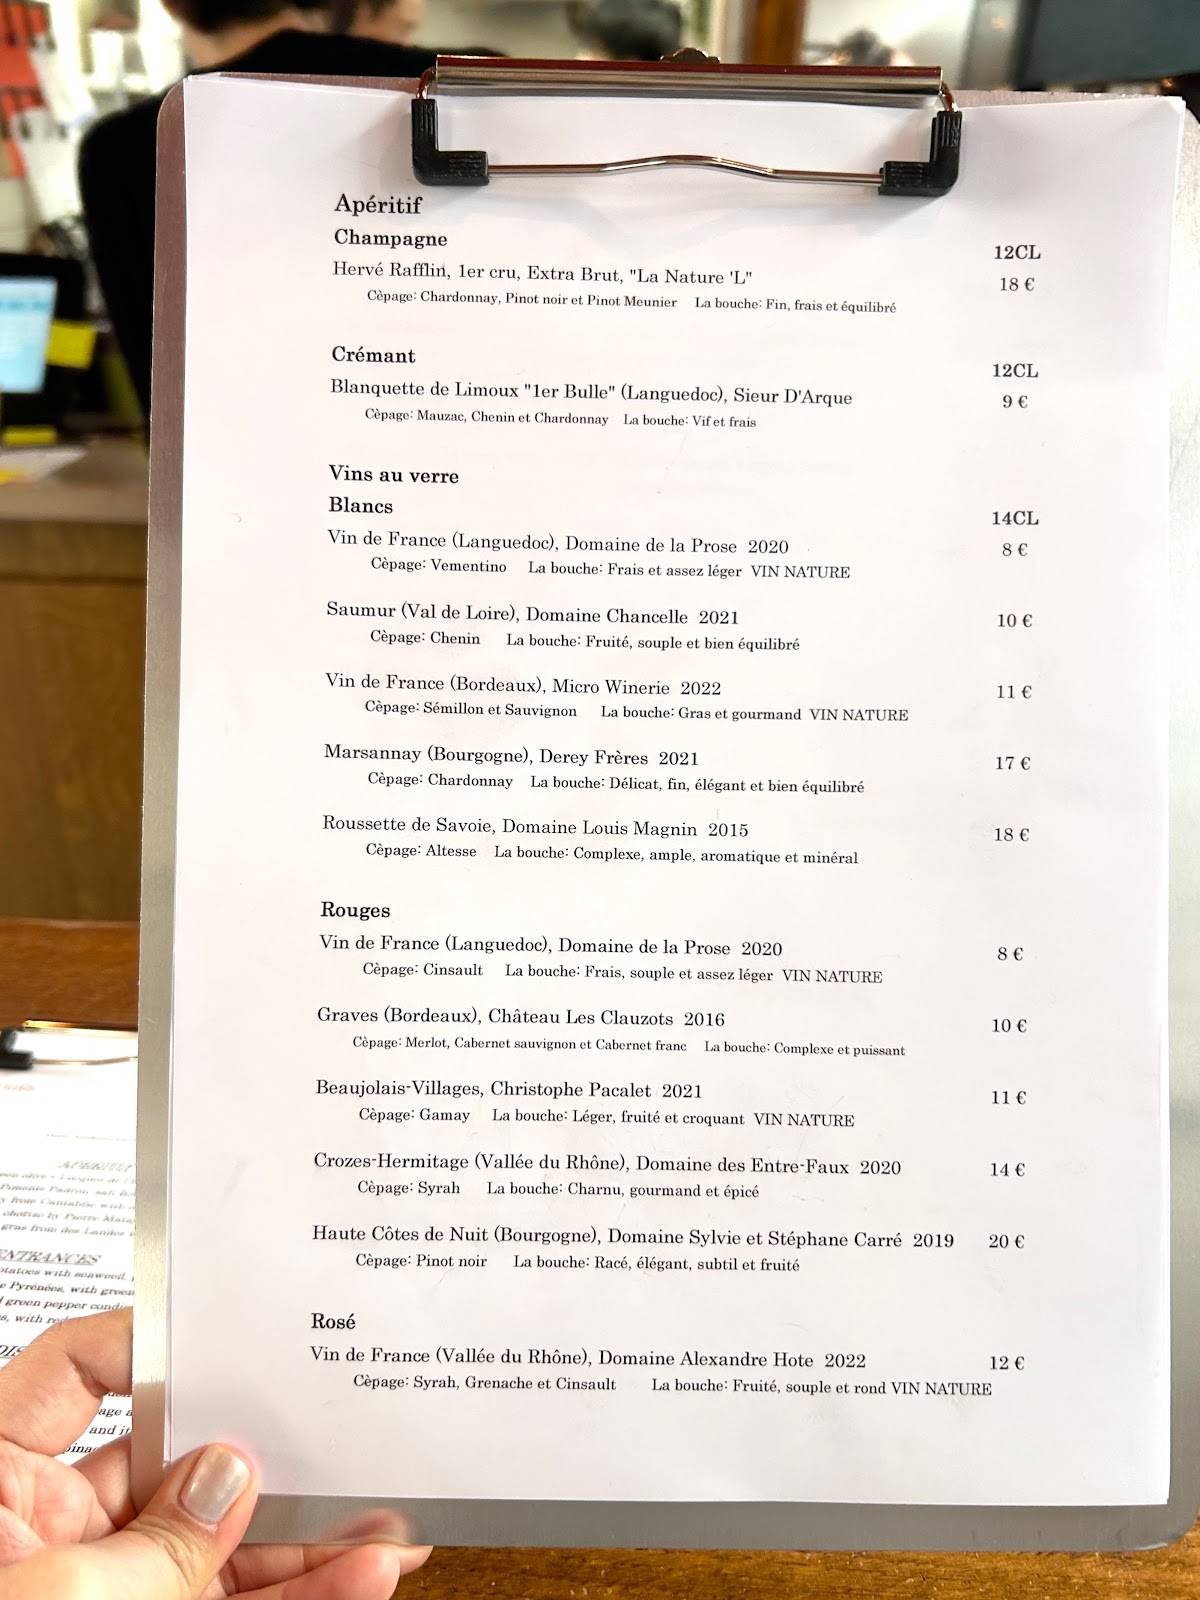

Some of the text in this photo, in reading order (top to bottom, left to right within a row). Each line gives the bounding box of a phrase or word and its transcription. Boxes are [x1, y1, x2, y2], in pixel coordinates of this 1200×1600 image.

[333, 192, 424, 217] Apéritif
[334, 227, 448, 250] Champagne
[994, 244, 1042, 260] 12CL
[332, 260, 384, 277] Hervé
[388, 261, 451, 281] Rafflin,
[458, 263, 485, 279] 1er
[489, 268, 521, 282] cru,
[527, 264, 575, 281] Extra
[580, 266, 624, 285] Brut,
[664, 268, 725, 285] Nature
[1000, 276, 1035, 292] 18 €
[367, 289, 897, 315] Cèpage: Chardonnay, Pinot noir et Pinot Meunier La bouche: Fin, frais et équilibré
[331, 345, 416, 364] Crémant
[992, 362, 1039, 379] 12CL
[330, 378, 425, 398] Blanquette
[430, 380, 450, 397] de
[455, 381, 520, 398] Limoux
[620, 382, 728, 405] (Languedoc),
[733, 387, 780, 403] Sieur
[1002, 394, 1029, 409] 9 €
[328, 463, 460, 485] Vins au verre
[328, 495, 394, 515] Blancs
[992, 510, 1040, 526] 14CL
[1001, 542, 1028, 557] 8 €
[326, 600, 739, 625] Saumur (Val de Loire), Domaine Chancelle 2021
[997, 613, 1033, 628] 10 €
[997, 684, 1033, 700] 11 €
[323, 743, 699, 767] Marsannay (Bourgogne), Derey Frères 2021
[995, 755, 1031, 771] 17 €
[994, 827, 1030, 842] 18 €
[365, 842, 859, 865] Cèpage: Altesse La bouche: Complexe, ample, aromatique et minéral
[319, 900, 391, 922] Rouges
[997, 946, 1024, 962] 8 €
[317, 1004, 726, 1028] Graves (Bordeaux), Château Les Clauzots 2016
[992, 1018, 1028, 1034] 10 €
[352, 1035, 906, 1058] Cèpage: Merlot, Cabernet sauvignon et Cabernet franc La bouche: Complexe et puissant
[315, 1079, 702, 1100] Beaujolais-Villages, Christophe Pacalet 2021
[991, 1090, 1027, 1105] 11 €
[990, 1162, 1026, 1177] 14 €
[311, 1224, 955, 1250] Haute Côtes de Nuit (Bourgogne), Domaine Sylvie et Stéphane Carré 2019
[988, 1233, 1025, 1249] 20 €
[44, 1268, 71, 1278] with
[70, 1284, 98, 1294] with
[5, 1298, 41, 1307] green
[43, 1300, 87, 1310] pepper
[15, 1313, 43, 1324] with
[310, 1312, 356, 1330] Rosé
[989, 1355, 1025, 1371] 12 €
[353, 1373, 992, 1397] Cèpage: Syrah, Grenache et Cinsault La bouche: Fruité, souple et rond VIN NATURE
[88, 1425, 117, 1435] and
